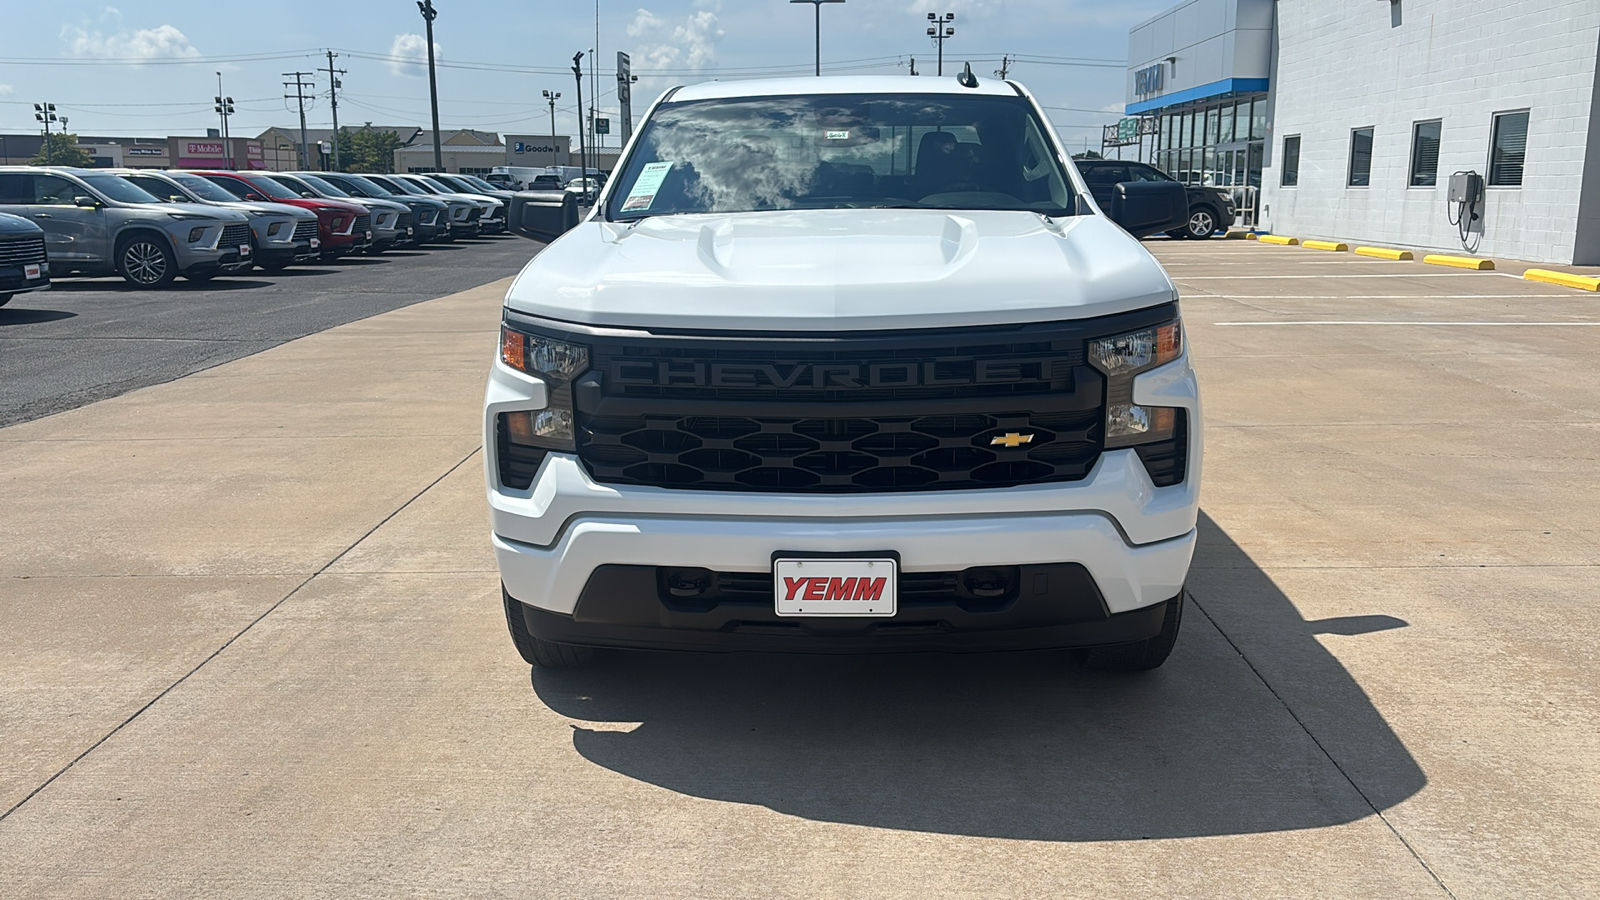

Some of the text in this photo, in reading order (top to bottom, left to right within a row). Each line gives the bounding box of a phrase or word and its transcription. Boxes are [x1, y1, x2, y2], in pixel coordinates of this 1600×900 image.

[525, 145, 560, 153] Goodwll
[610, 355, 1070, 389] CHEVROLET
[783, 577, 888, 601] YEMM
